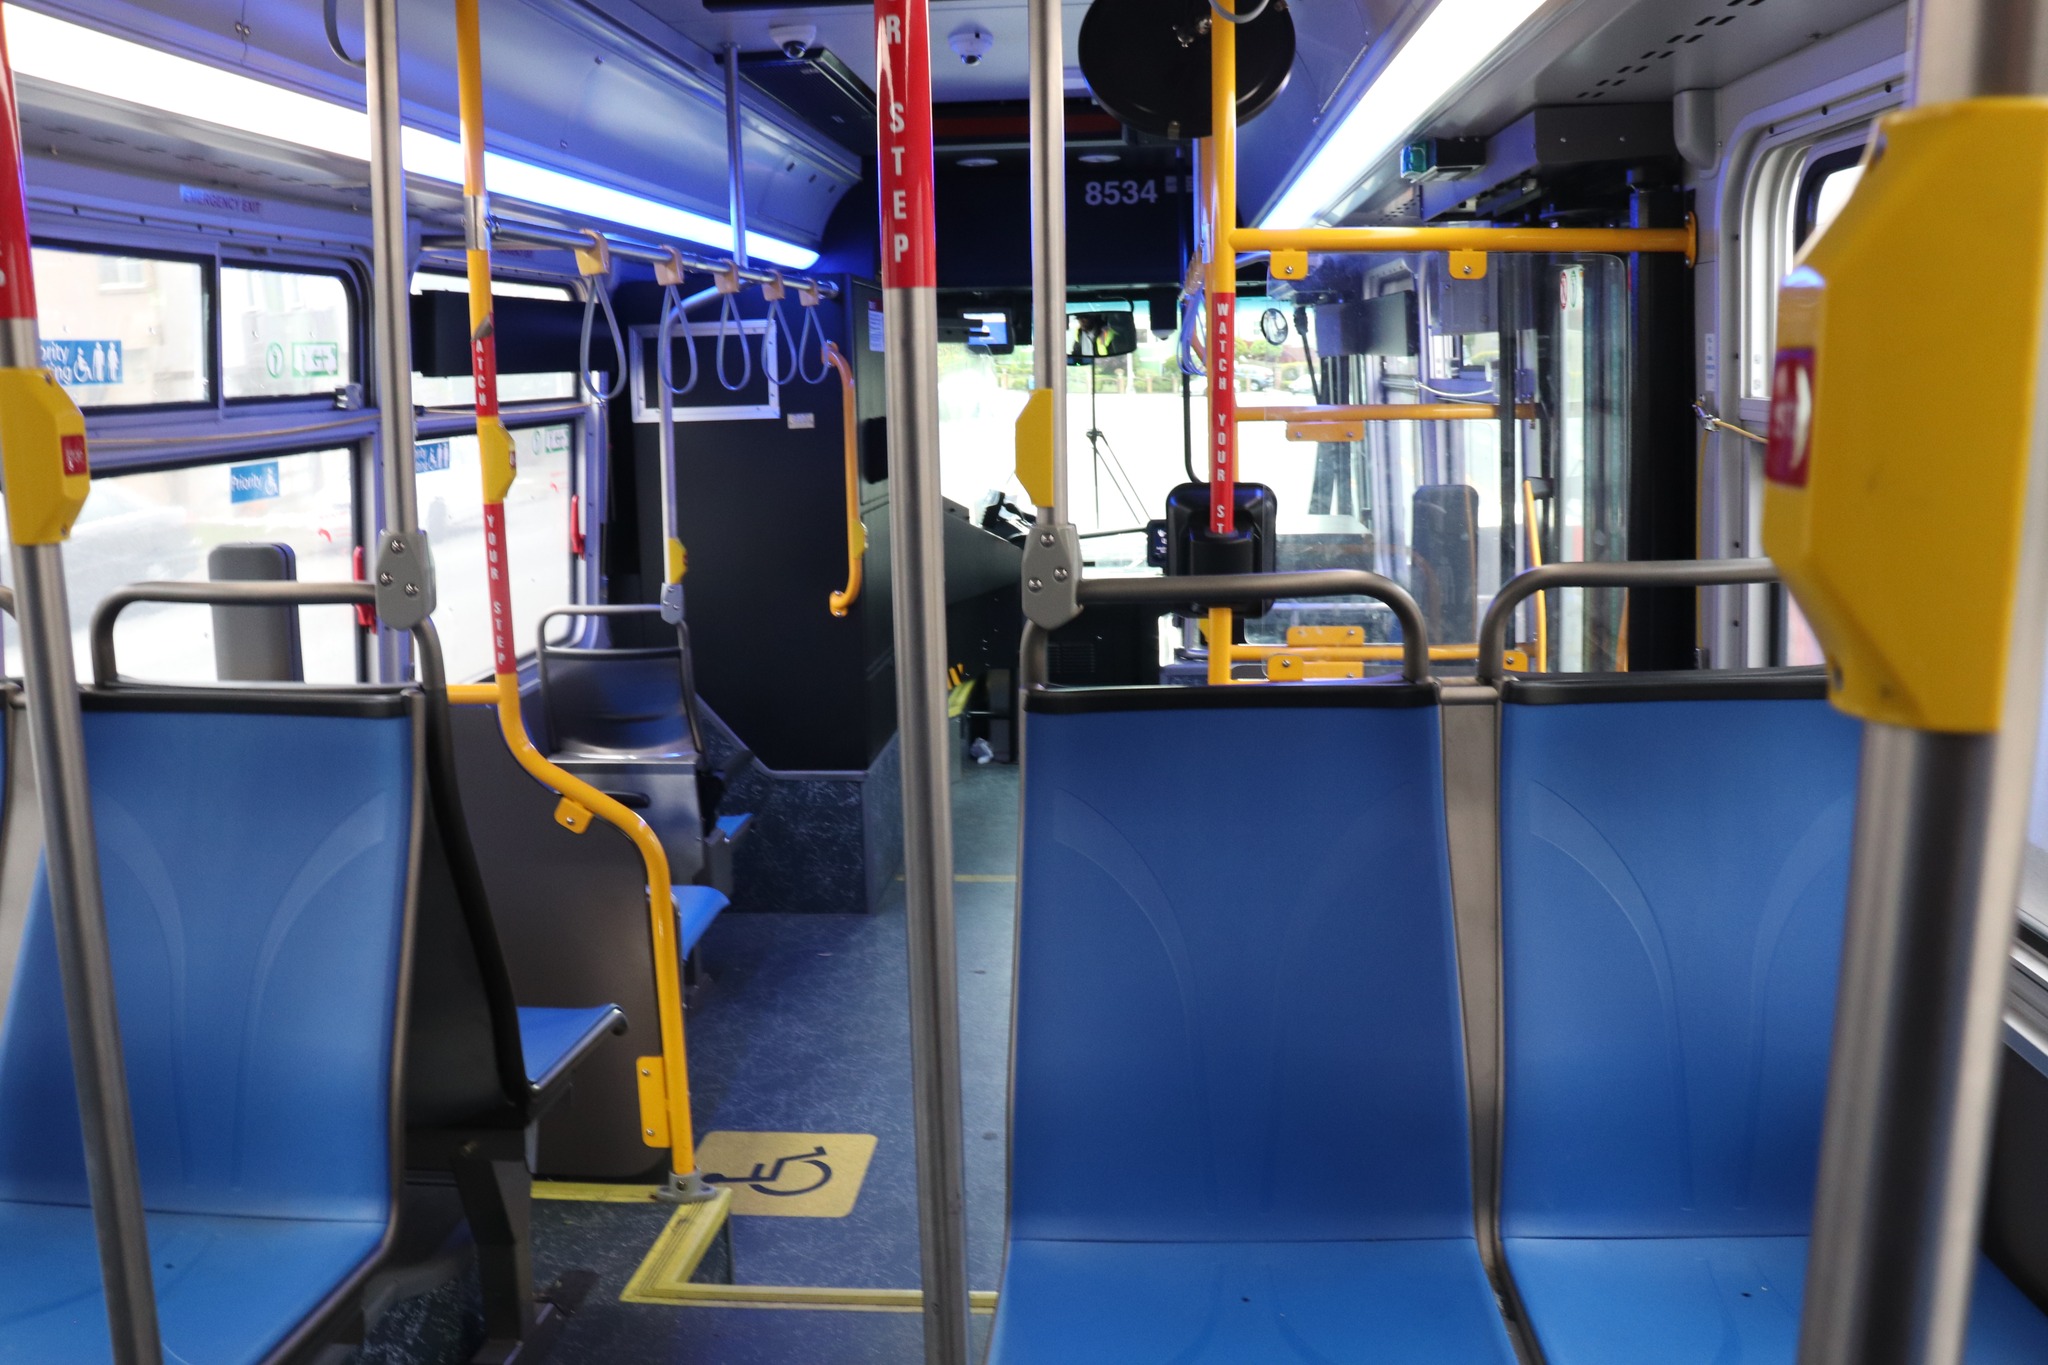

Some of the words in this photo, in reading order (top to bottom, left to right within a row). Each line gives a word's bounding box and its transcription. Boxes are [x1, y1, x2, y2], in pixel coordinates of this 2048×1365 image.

[884, 10, 902, 45] R
[889, 101, 909, 263] STEP
[1084, 179, 1159, 206] 8534
[1216, 303, 1229, 391] WATCH
[46, 360, 72, 385] ting
[1216, 413, 1227, 482] YOUR
[232, 473, 262, 492] Priority
[475, 338, 487, 407] ATCH
[486, 514, 499, 581] YOUR
[493, 601, 506, 665] STEP
[1216, 503, 1227, 535] ST
